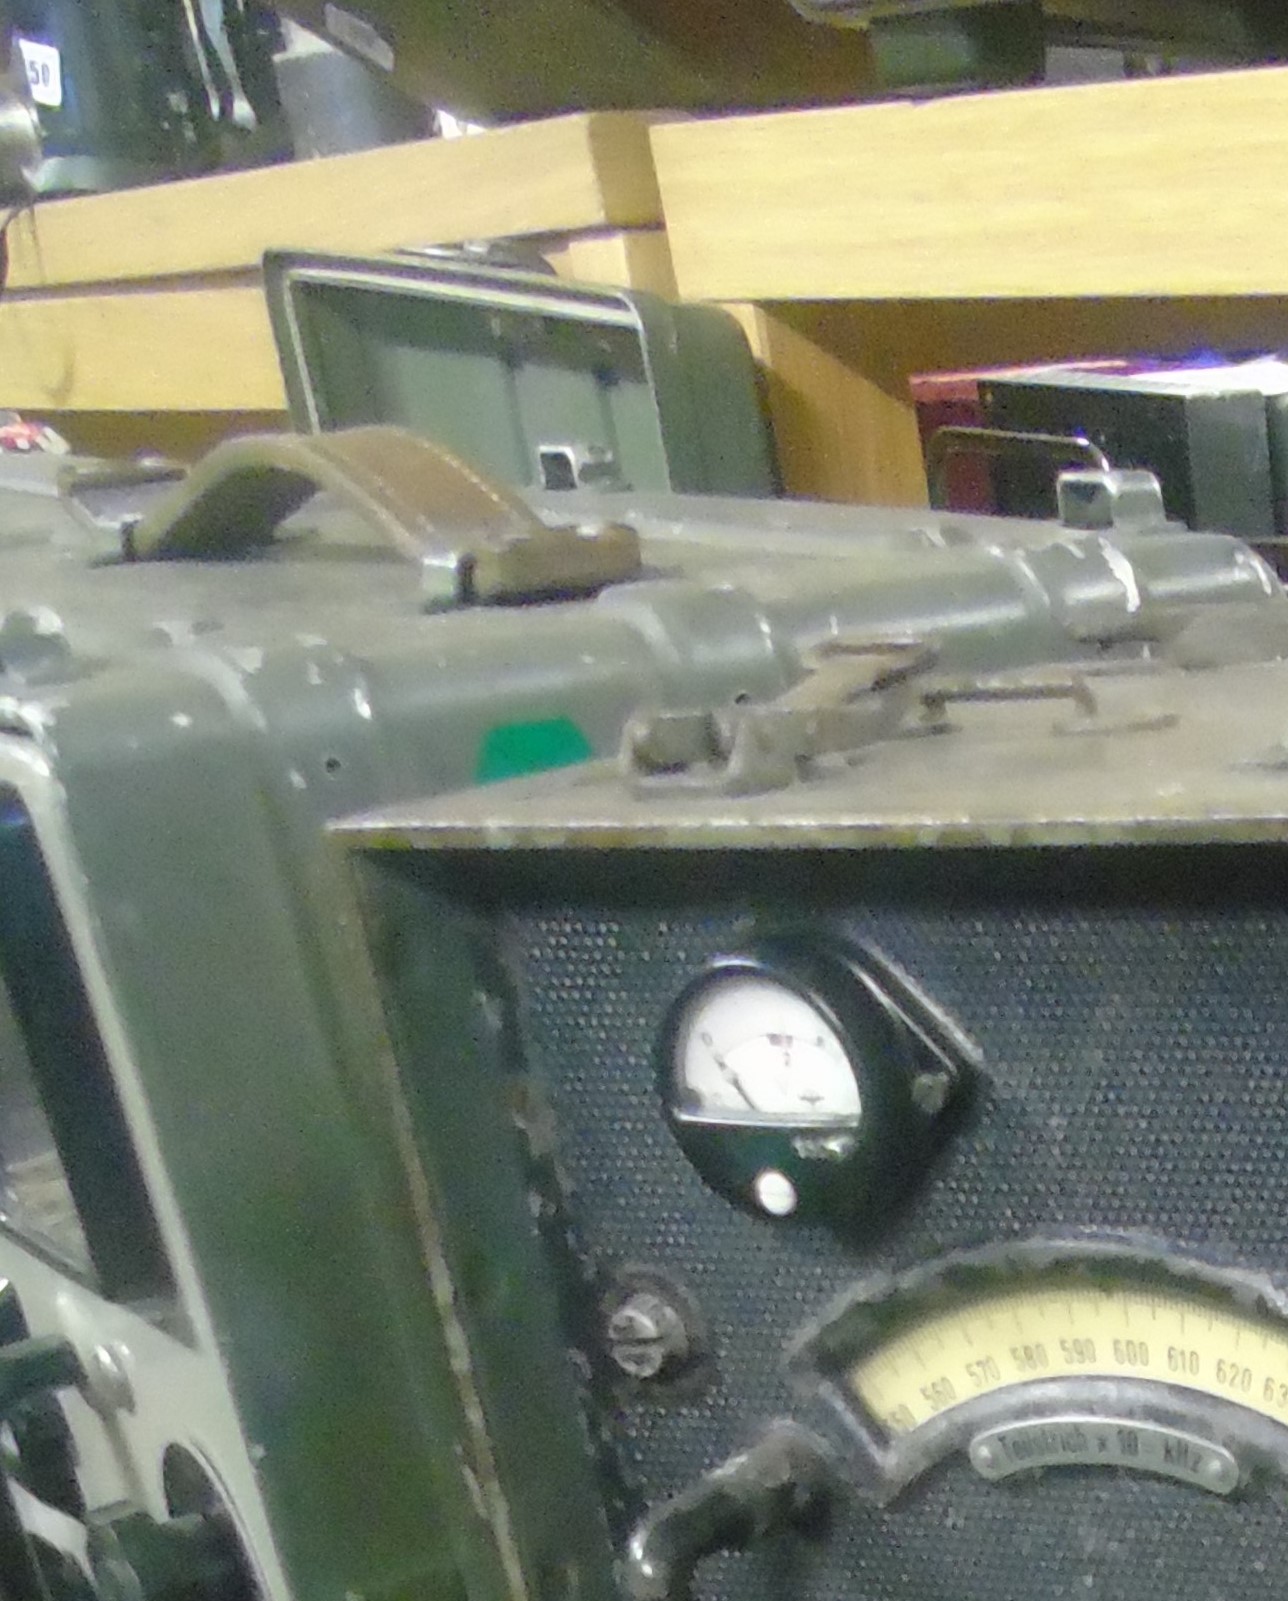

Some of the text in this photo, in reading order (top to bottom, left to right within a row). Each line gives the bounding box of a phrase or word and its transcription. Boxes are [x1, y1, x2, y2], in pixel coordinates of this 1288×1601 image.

[919, 1376, 957, 1411] 560
[965, 1355, 1002, 1388] 570
[1011, 1343, 1050, 1373] 580
[1059, 1338, 1097, 1365] 590
[1113, 1338, 1150, 1368] 600
[1166, 1346, 1201, 1377] 610
[1216, 1358, 1254, 1393] 620
